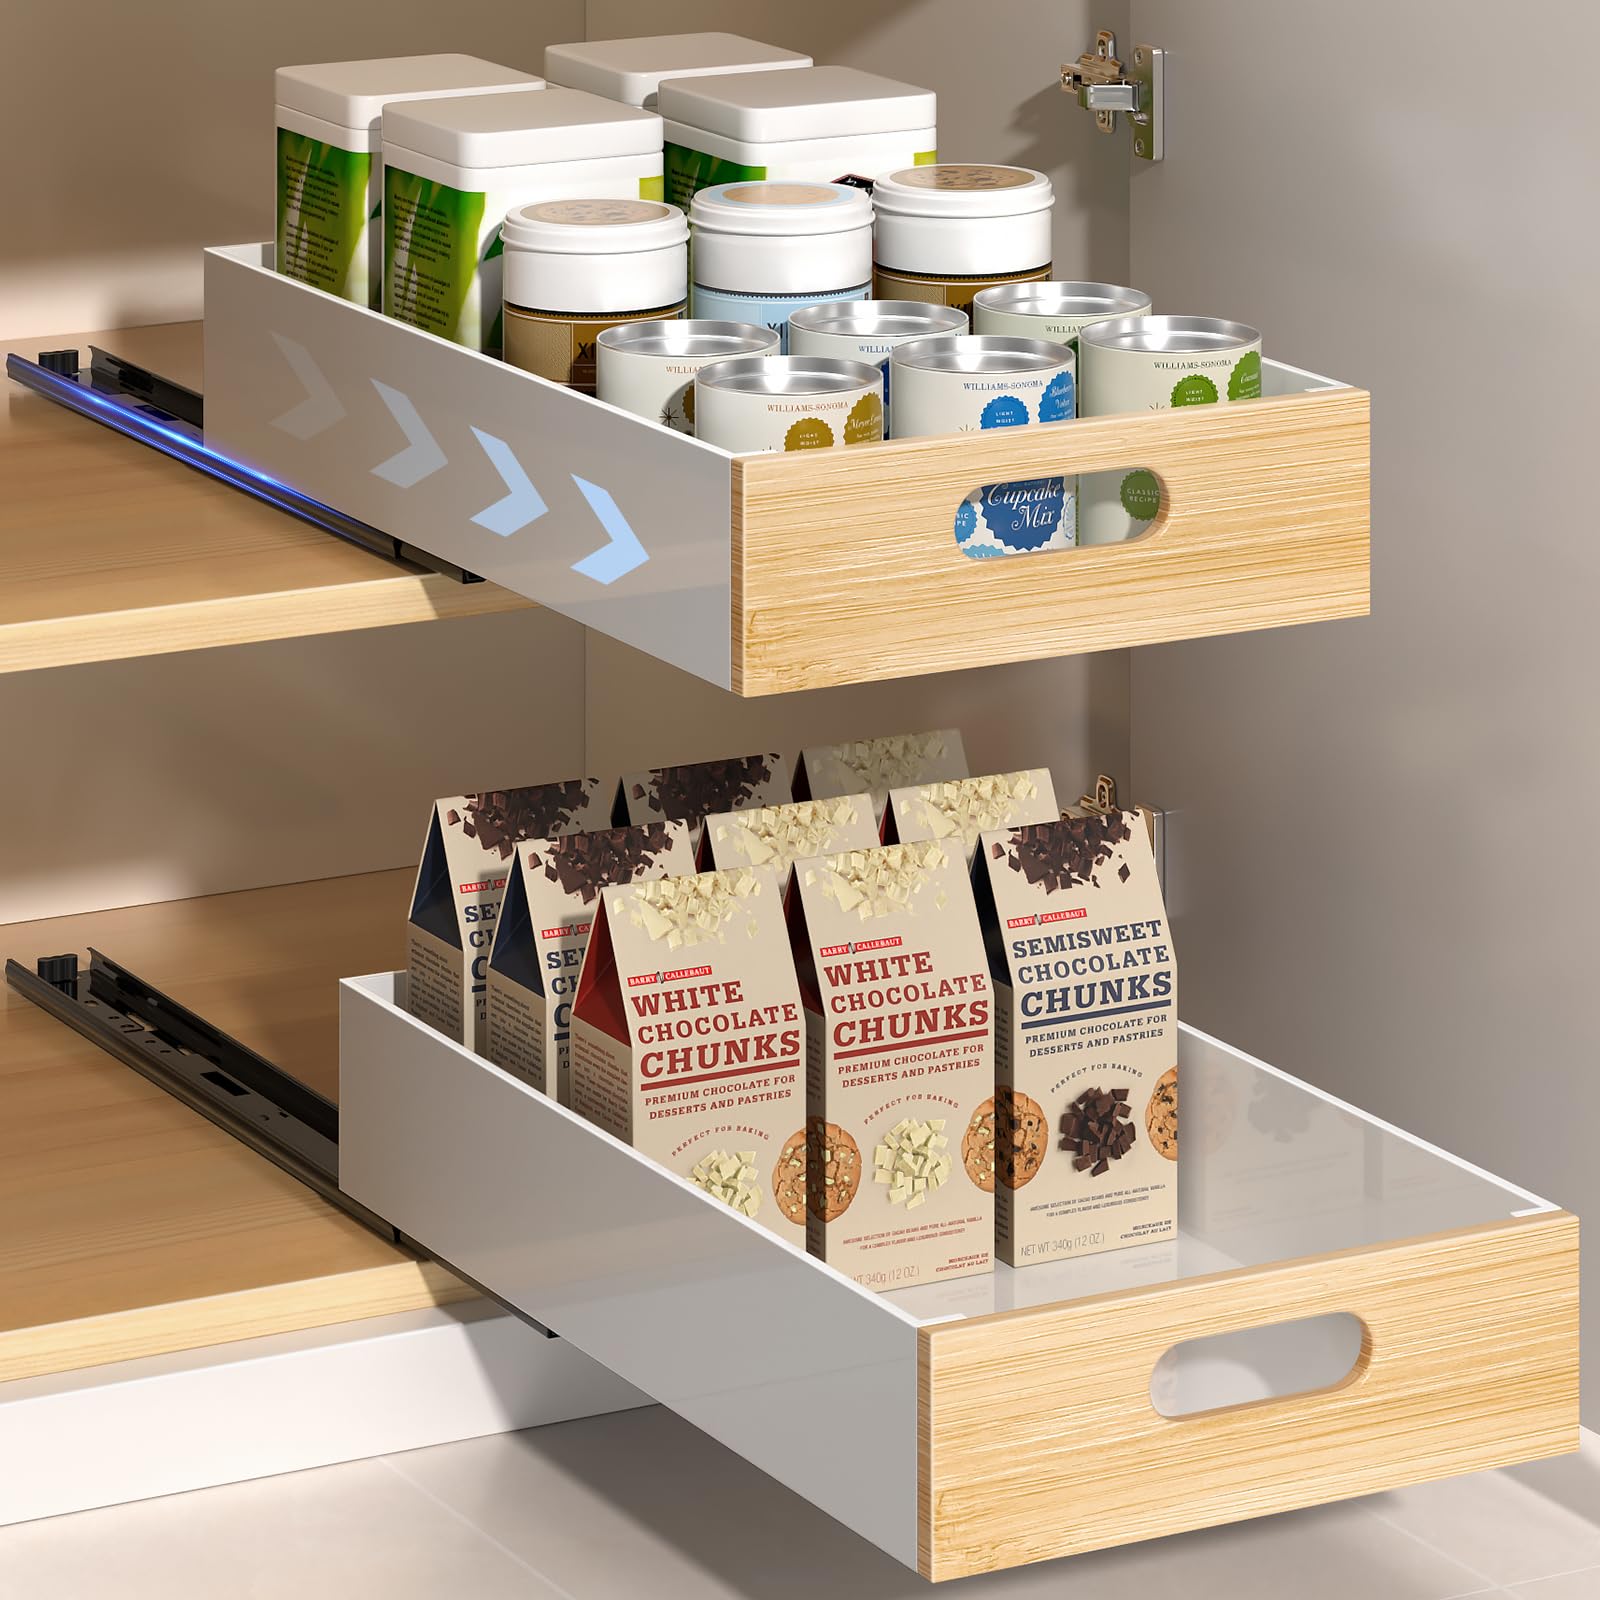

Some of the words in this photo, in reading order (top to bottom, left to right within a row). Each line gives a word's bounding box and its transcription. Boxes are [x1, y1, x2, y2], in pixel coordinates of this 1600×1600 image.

[1153, 359, 1232, 370] WILLIAMS-SONOMA
[963, 380, 1043, 391] WILLIAMS-SONOMA
[768, 402, 848, 413] WILLIAMS-SONOMA
[987, 479, 1061, 511] Cupcake
[1127, 488, 1160, 496] CLASSIC
[1130, 496, 1157, 504] RECIPE
[1011, 503, 1055, 531] Mix
[543, 928, 569, 937] BARRY
[1008, 918, 1034, 928] BARRY
[1042, 909, 1085, 922] CALLEBAUT
[822, 946, 848, 956] BARRY
[856, 937, 901, 951] CALLEBAUT
[1012, 920, 1162, 959] SEMISWEET
[630, 976, 656, 986] BARRY
[664, 966, 711, 980] CALLEBAUT
[824, 951, 933, 988] WHITE
[1018, 945, 1169, 984] CHOCOLATE
[631, 980, 744, 1017] WHITE
[831, 973, 987, 1014] CHOCOLATE
[1021, 971, 1172, 1017] CHUNKS
[638, 1003, 798, 1045] CHOCOLATE
[833, 1000, 989, 1047] CHUNKS
[1025, 1029, 1076, 1044] PREMIUM
[1080, 1017, 1143, 1036] CHOCOLATE
[1147, 1014, 1168, 1025] FOR
[640, 1030, 801, 1078] CHUNKS
[1029, 1041, 1084, 1058] DESSERTS
[1086, 1037, 1110, 1049] AND
[1112, 1028, 1164, 1044] PASTRIES
[838, 1059, 891, 1075] PREMIUM
[894, 1048, 959, 1066] CHOCOLATE
[963, 1043, 984, 1056] FOR
[842, 1071, 898, 1088] DESSERTS
[901, 1067, 925, 1079] AND
[927, 1058, 981, 1075] PASTRIES
[1091, 1063, 1108, 1071] FOR
[645, 1085, 700, 1106] PREMIUM
[703, 1078, 770, 1097] CHOCOLATE
[774, 1074, 796, 1088] FOR
[649, 1103, 707, 1120] DESSERTS
[710, 1098, 734, 1110] AND
[738, 1089, 792, 1105] PASTRIES
[715, 1125, 732, 1133] FOR
[1020, 1243, 1036, 1256] NET
[1038, 1241, 1049, 1254] WT
[1052, 1239, 1072, 1251] 340g
[866, 1271, 886, 1285] 340g
